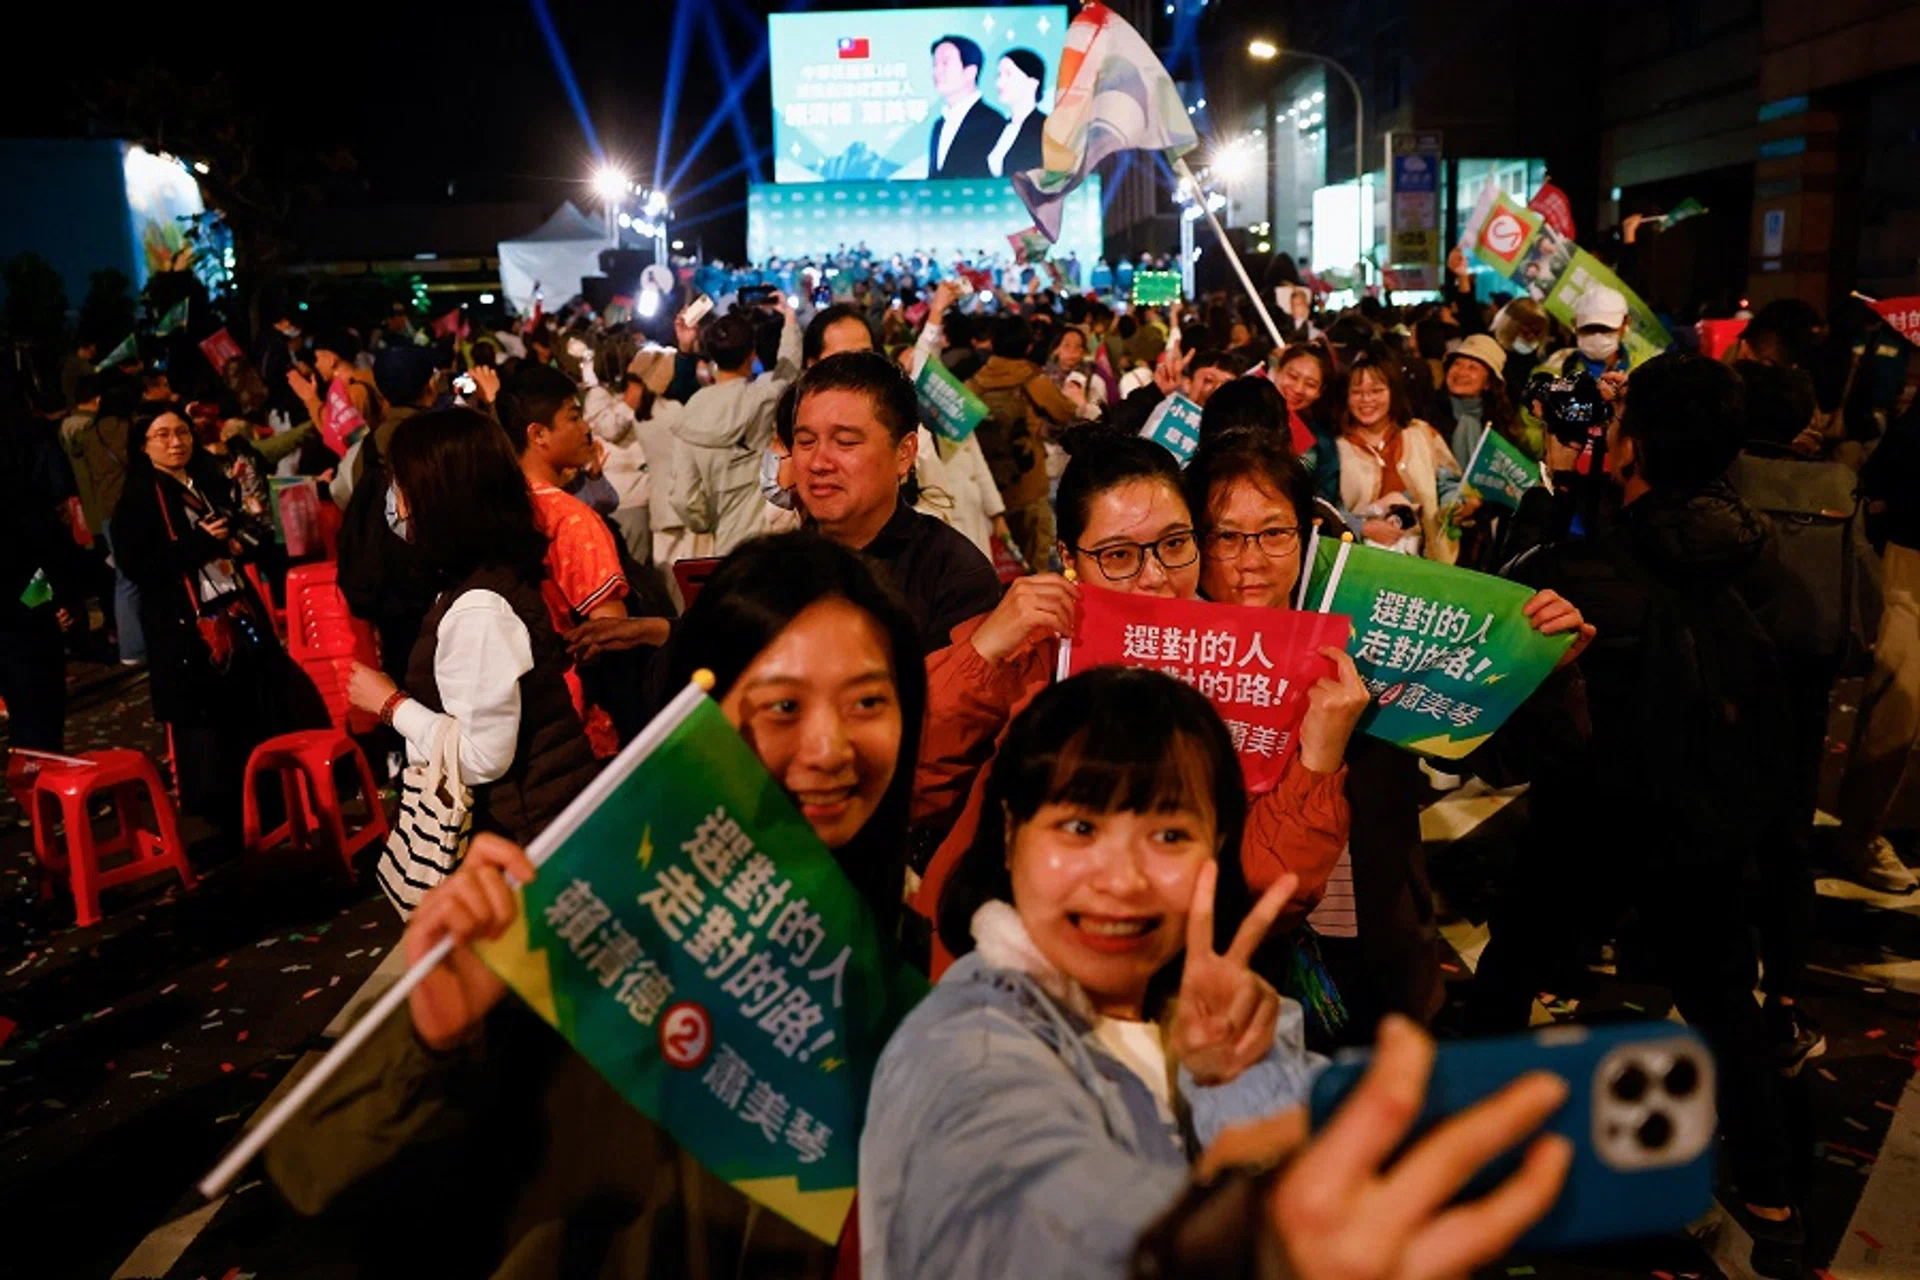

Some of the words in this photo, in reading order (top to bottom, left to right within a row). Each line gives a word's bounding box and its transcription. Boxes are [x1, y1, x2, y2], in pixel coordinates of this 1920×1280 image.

[1122, 623, 1275, 670] 選對的人
[1369, 588, 1495, 644] 選對的人
[1396, 682, 1483, 727] 蕭美琴
[637, 864, 836, 1064] 走對的路!
[680, 805, 854, 1008] 選對的人
[543, 877, 675, 1027] 賴清德
[701, 1042, 834, 1165] 蕭美琴
